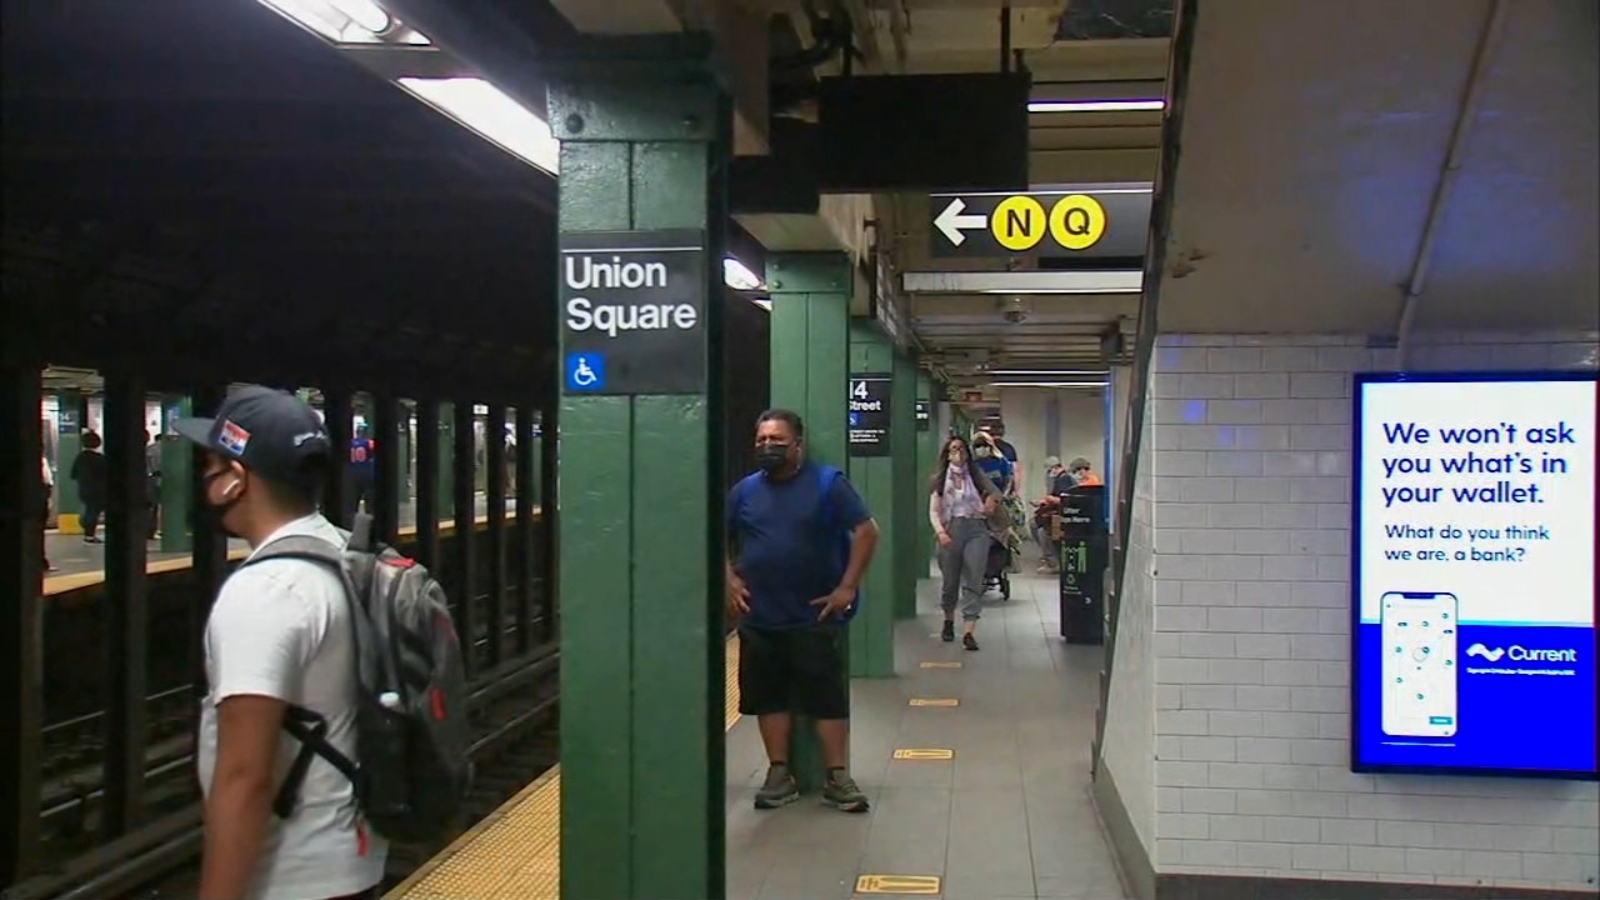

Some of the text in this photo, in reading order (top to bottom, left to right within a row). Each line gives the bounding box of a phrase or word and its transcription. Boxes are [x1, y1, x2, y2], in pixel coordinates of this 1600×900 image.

[1006, 207, 1091, 238] N Q
[565, 256, 667, 289] Union
[566, 297, 697, 338] Square
[849, 381, 869, 400] 14
[1383, 421, 1576, 444] We won't ask
[1382, 451, 1567, 479] you what's in
[1382, 480, 1544, 508] your wallet.
[1385, 524, 1550, 542] What do you think
[1385, 550, 1412, 561] we
[1454, 550, 1466, 561] a
[1470, 547, 1526, 562] bank?
[1508, 645, 1577, 662] Current
